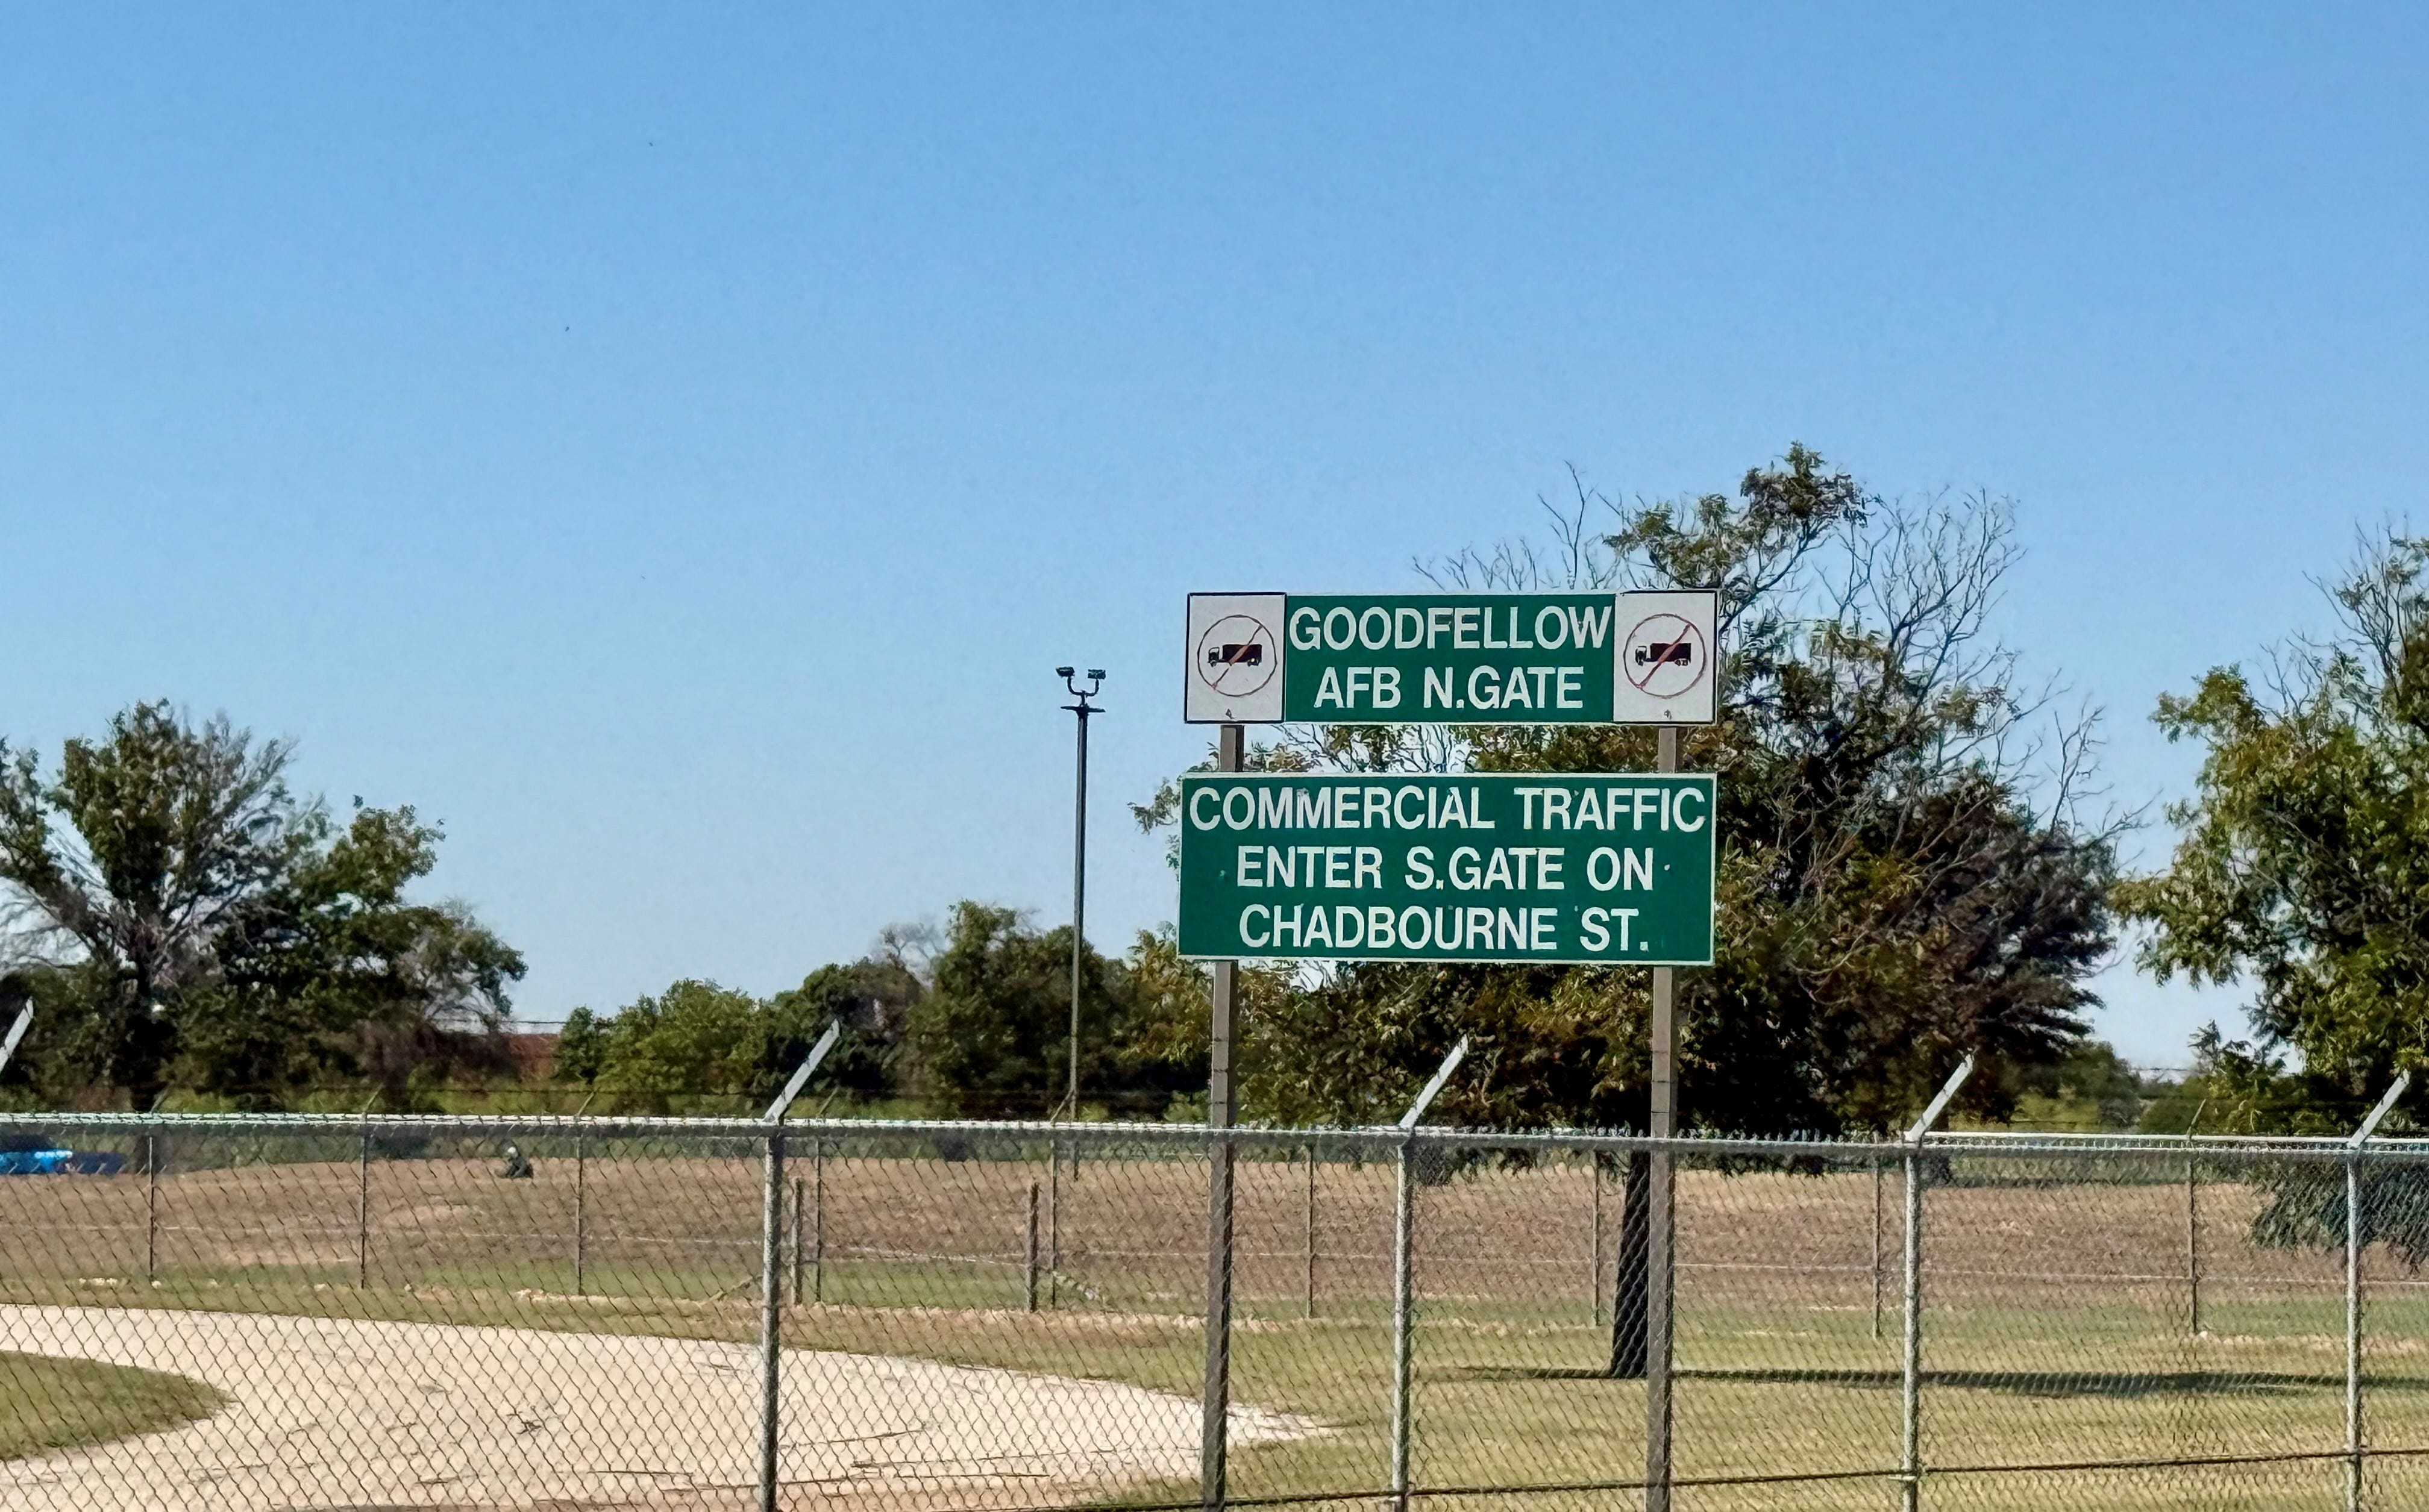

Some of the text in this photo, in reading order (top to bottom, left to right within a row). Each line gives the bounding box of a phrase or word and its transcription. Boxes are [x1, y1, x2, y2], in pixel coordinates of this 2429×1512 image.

[1290, 606, 1612, 650] GOODFELLOW
[1314, 666, 1584, 710] AFB N.GATE
[1189, 787, 1706, 832] COMMERCIAL TRAFFIC
[1237, 846, 1653, 891] ENTER S.GATE ON
[1240, 904, 1649, 952] CHADBOURNE ST.
